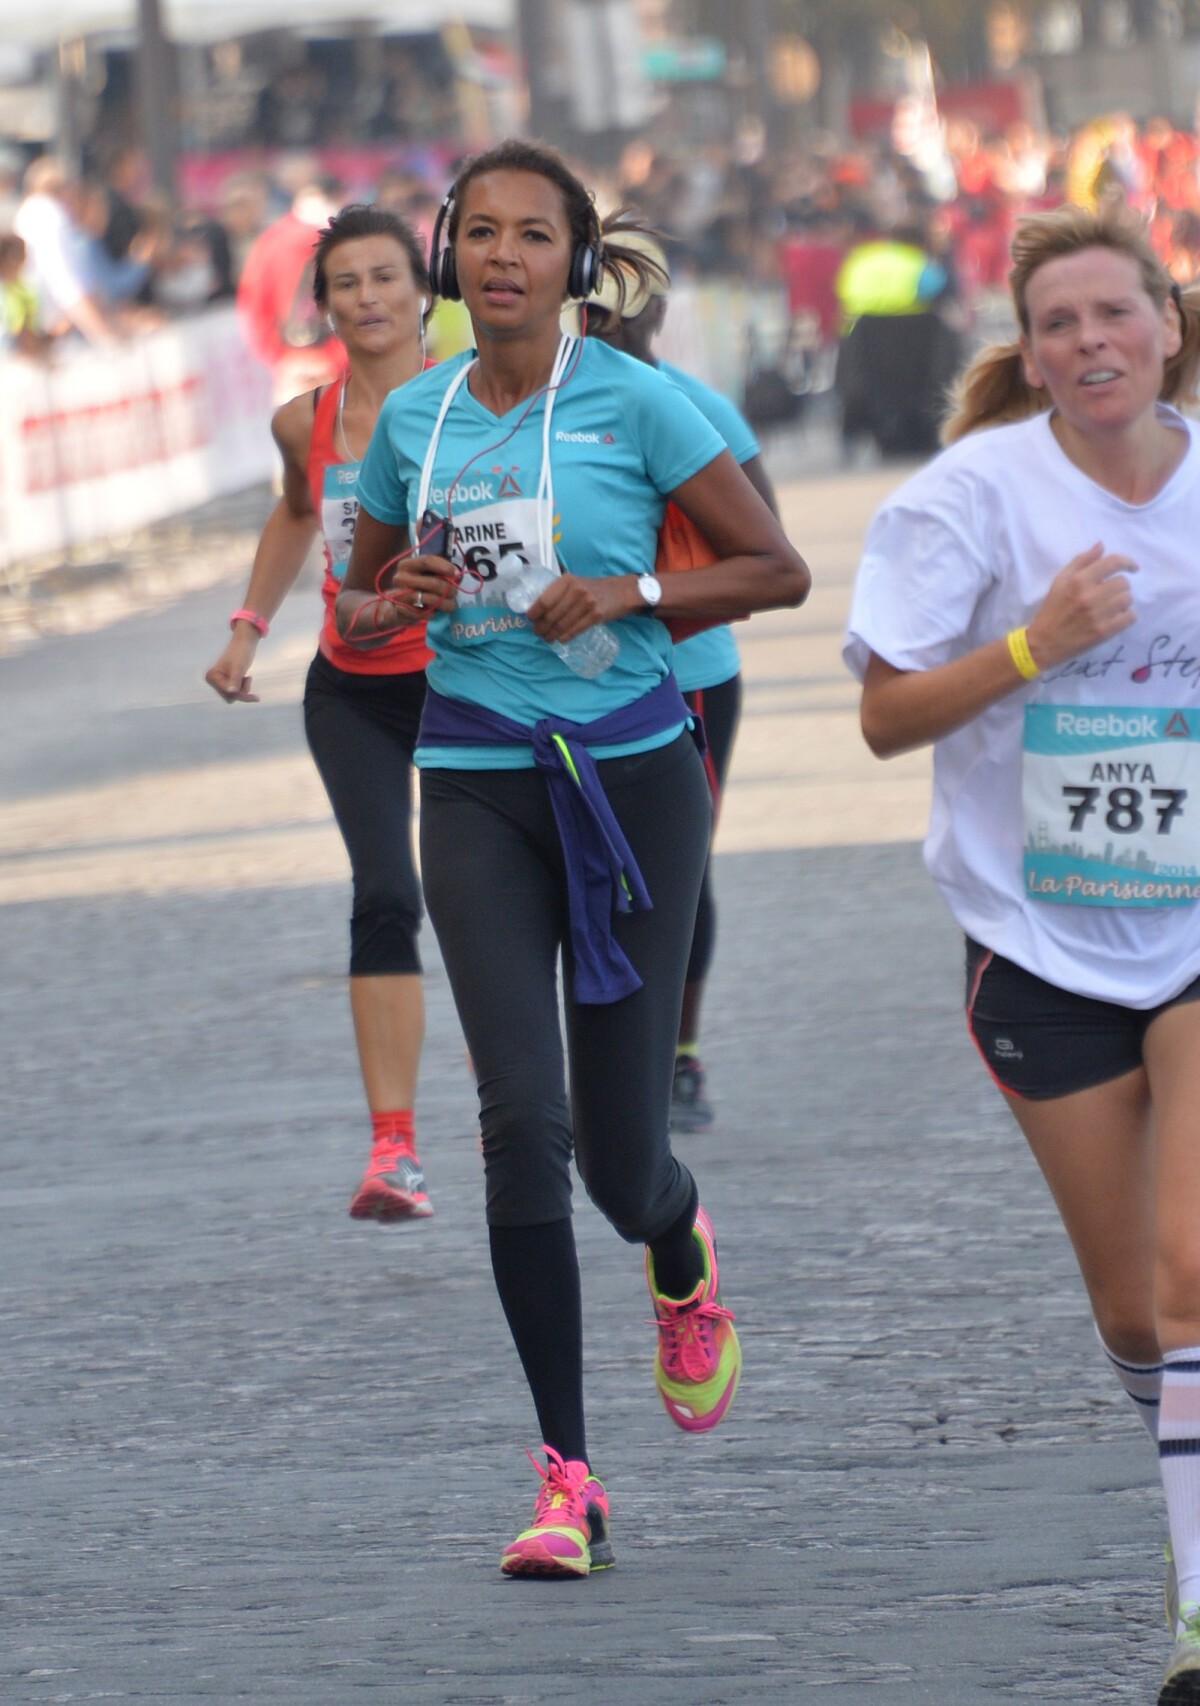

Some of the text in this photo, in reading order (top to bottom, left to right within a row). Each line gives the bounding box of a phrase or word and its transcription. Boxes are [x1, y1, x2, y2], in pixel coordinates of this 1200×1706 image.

[556, 431, 600, 444] Reebok
[429, 481, 494, 504] eebok
[453, 522, 506, 544] ARINE
[452, 542, 530, 582] 65
[454, 615, 525, 640] Parisie
[1040, 645, 1125, 684] ext
[1055, 712, 1157, 738] Reebok
[1090, 763, 1156, 784] ANYA
[1062, 786, 1188, 835] 787
[1028, 870, 1061, 893] La
